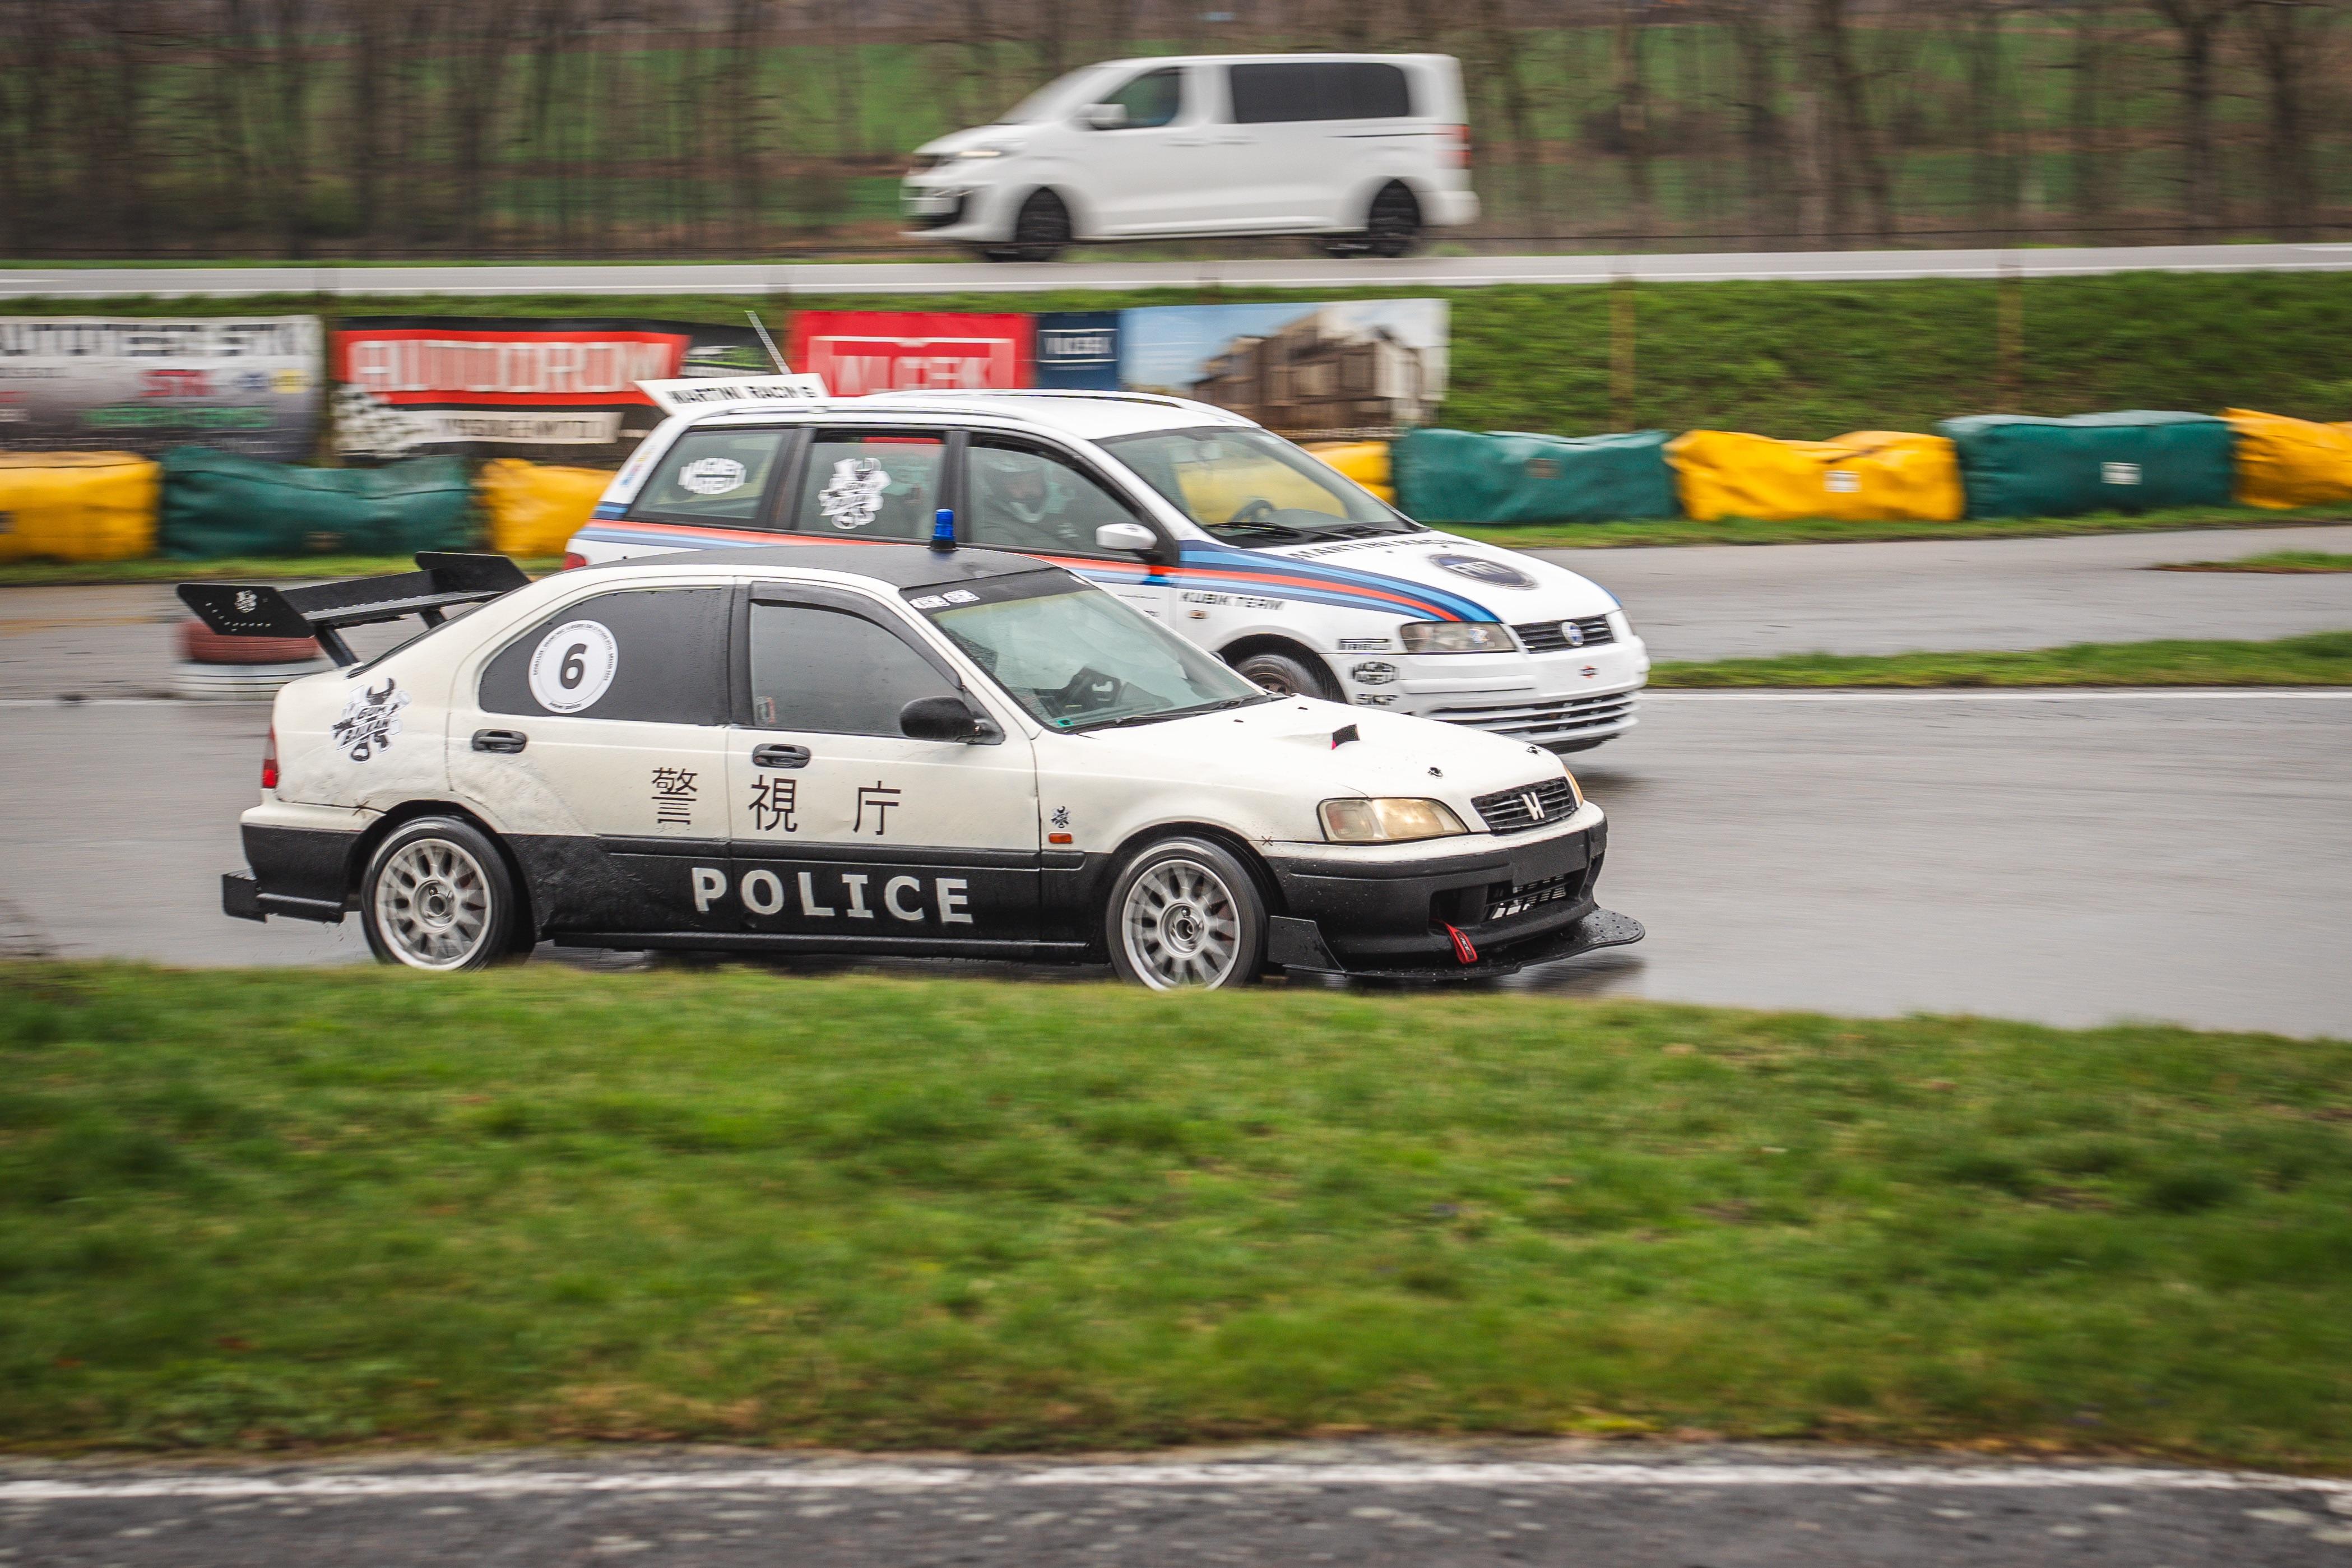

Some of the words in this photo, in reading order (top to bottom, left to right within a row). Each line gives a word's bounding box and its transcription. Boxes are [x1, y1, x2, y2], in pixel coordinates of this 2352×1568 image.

[1288, 541, 1399, 560] MARTINI
[561, 643, 587, 689] 6
[651, 767, 901, 835] 警視庁
[692, 867, 973, 925] POLICE
